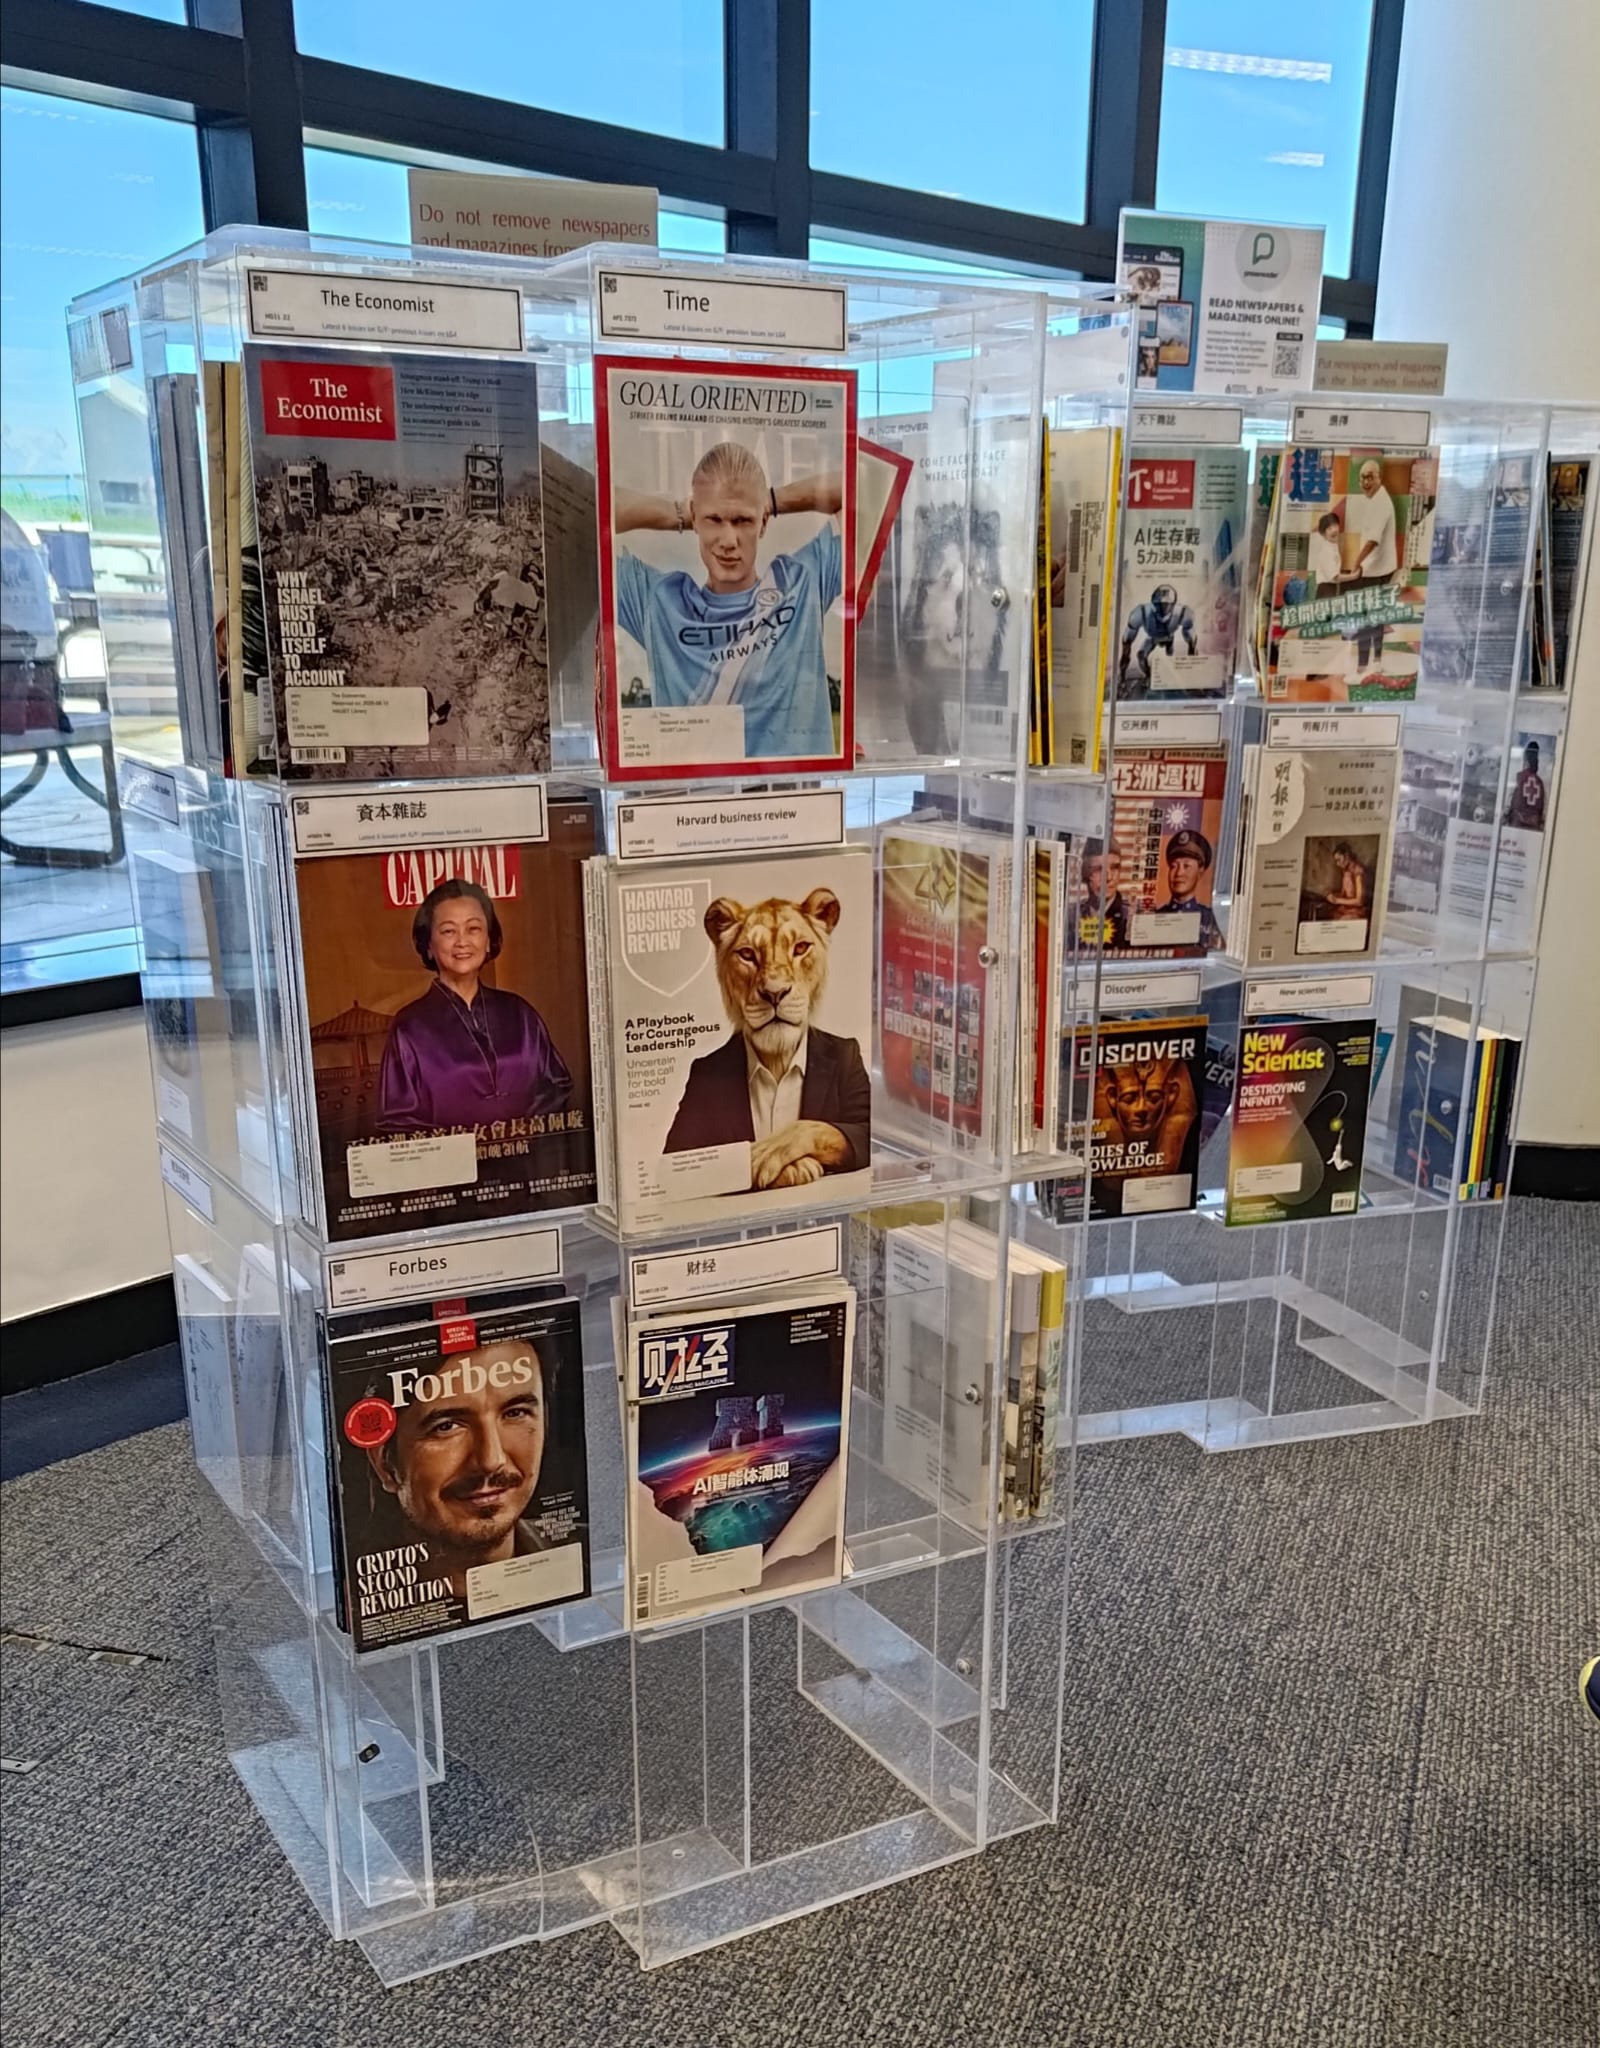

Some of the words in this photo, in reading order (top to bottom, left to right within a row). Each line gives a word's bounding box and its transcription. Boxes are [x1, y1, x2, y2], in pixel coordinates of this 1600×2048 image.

[419, 203, 444, 222] Do
[456, 210, 480, 226] not
[493, 213, 550, 230] remove
[562, 217, 650, 240] newspapers
[422, 233, 450, 249] and
[320, 289, 350, 307] The
[355, 292, 435, 313] Economist
[663, 289, 710, 312] Time
[1209, 298, 1234, 308] READ
[1235, 300, 1296, 313] NEWSPAPERS
[1297, 304, 1305, 313] &
[1208, 312, 1263, 324] MAGAZINES
[1264, 315, 1301, 326] ONLINE!
[310, 378, 348, 399] The
[619, 380, 685, 406] GOAL
[690, 384, 807, 415] ORIENTED
[277, 397, 383, 424] Economist
[1136, 413, 1177, 426] 天下雜誌
[629, 411, 654, 421] STRIKER
[655, 413, 678, 421] ERLING
[679, 414, 707, 423] HAALAND
[708, 415, 714, 423] IS
[715, 416, 741, 425] CHASING
[742, 417, 772, 426] HISTORY'S
[773, 419, 801, 428] GREATEST
[801, 420, 827, 429] SCORERS
[897, 422, 929, 433] ROVER
[1134, 527, 1200, 546] AI生存戰
[1137, 549, 1195, 565] 5力決勝負
[276, 571, 308, 588] WHY
[277, 588, 326, 605] ISRAEL
[279, 605, 316, 621] MUST
[280, 621, 316, 637] HOLD
[679, 605, 796, 646] ETIHAD
[282, 637, 327, 654] ITSELF
[709, 633, 778, 664] AIRWAYS
[284, 654, 301, 670] TO
[285, 670, 346, 687] ACCOUNT
[1121, 720, 1159, 731] 亞洲週刊
[1302, 721, 1339, 733] 明報月刊
[356, 801, 428, 823] 資本雜誌
[676, 812, 717, 827] Harvard
[720, 810, 762, 824] business
[764, 809, 797, 820] review
[386, 845, 516, 906] CAPITAL
[624, 887, 694, 912] HARVARD
[626, 908, 696, 933] BUSINESS
[627, 930, 682, 954] REVIEW
[1104, 983, 1148, 995] Discover
[1279, 987, 1297, 996] New
[1298, 986, 1328, 995] scientist
[624, 1018, 635, 1030] A
[637, 1013, 695, 1029] Playbook
[625, 1030, 645, 1041] for
[646, 1023, 720, 1040] Courageous
[626, 1036, 696, 1054] Leadership
[1244, 1032, 1287, 1053] New
[1079, 1038, 1196, 1067] DISCOVER
[1242, 1047, 1326, 1075] Scientist
[626, 1056, 676, 1070] Uncertain
[627, 1069, 656, 1079] times
[657, 1066, 675, 1076] call
[627, 1078, 642, 1089] for
[643, 1076, 666, 1087] bold
[1240, 1081, 1306, 1097] DESTROYING
[628, 1089, 660, 1099] action.
[1239, 1094, 1285, 1108] INFINITY
[1128, 1141, 1149, 1155] OF
[1089, 1152, 1165, 1174] OWLEDGE
[389, 1256, 448, 1277] Forbes
[686, 1258, 717, 1277] 财经
[446, 1326, 469, 1334] SPECIAL
[642, 1330, 729, 1388] 财经
[386, 1356, 532, 1408] Forbes
[694, 1377, 729, 1388] MAGAZINE
[692, 1460, 790, 1496] AI智能体涌现
[358, 1565, 418, 1597] SECOND
[360, 1576, 454, 1617] REVOLUTION
